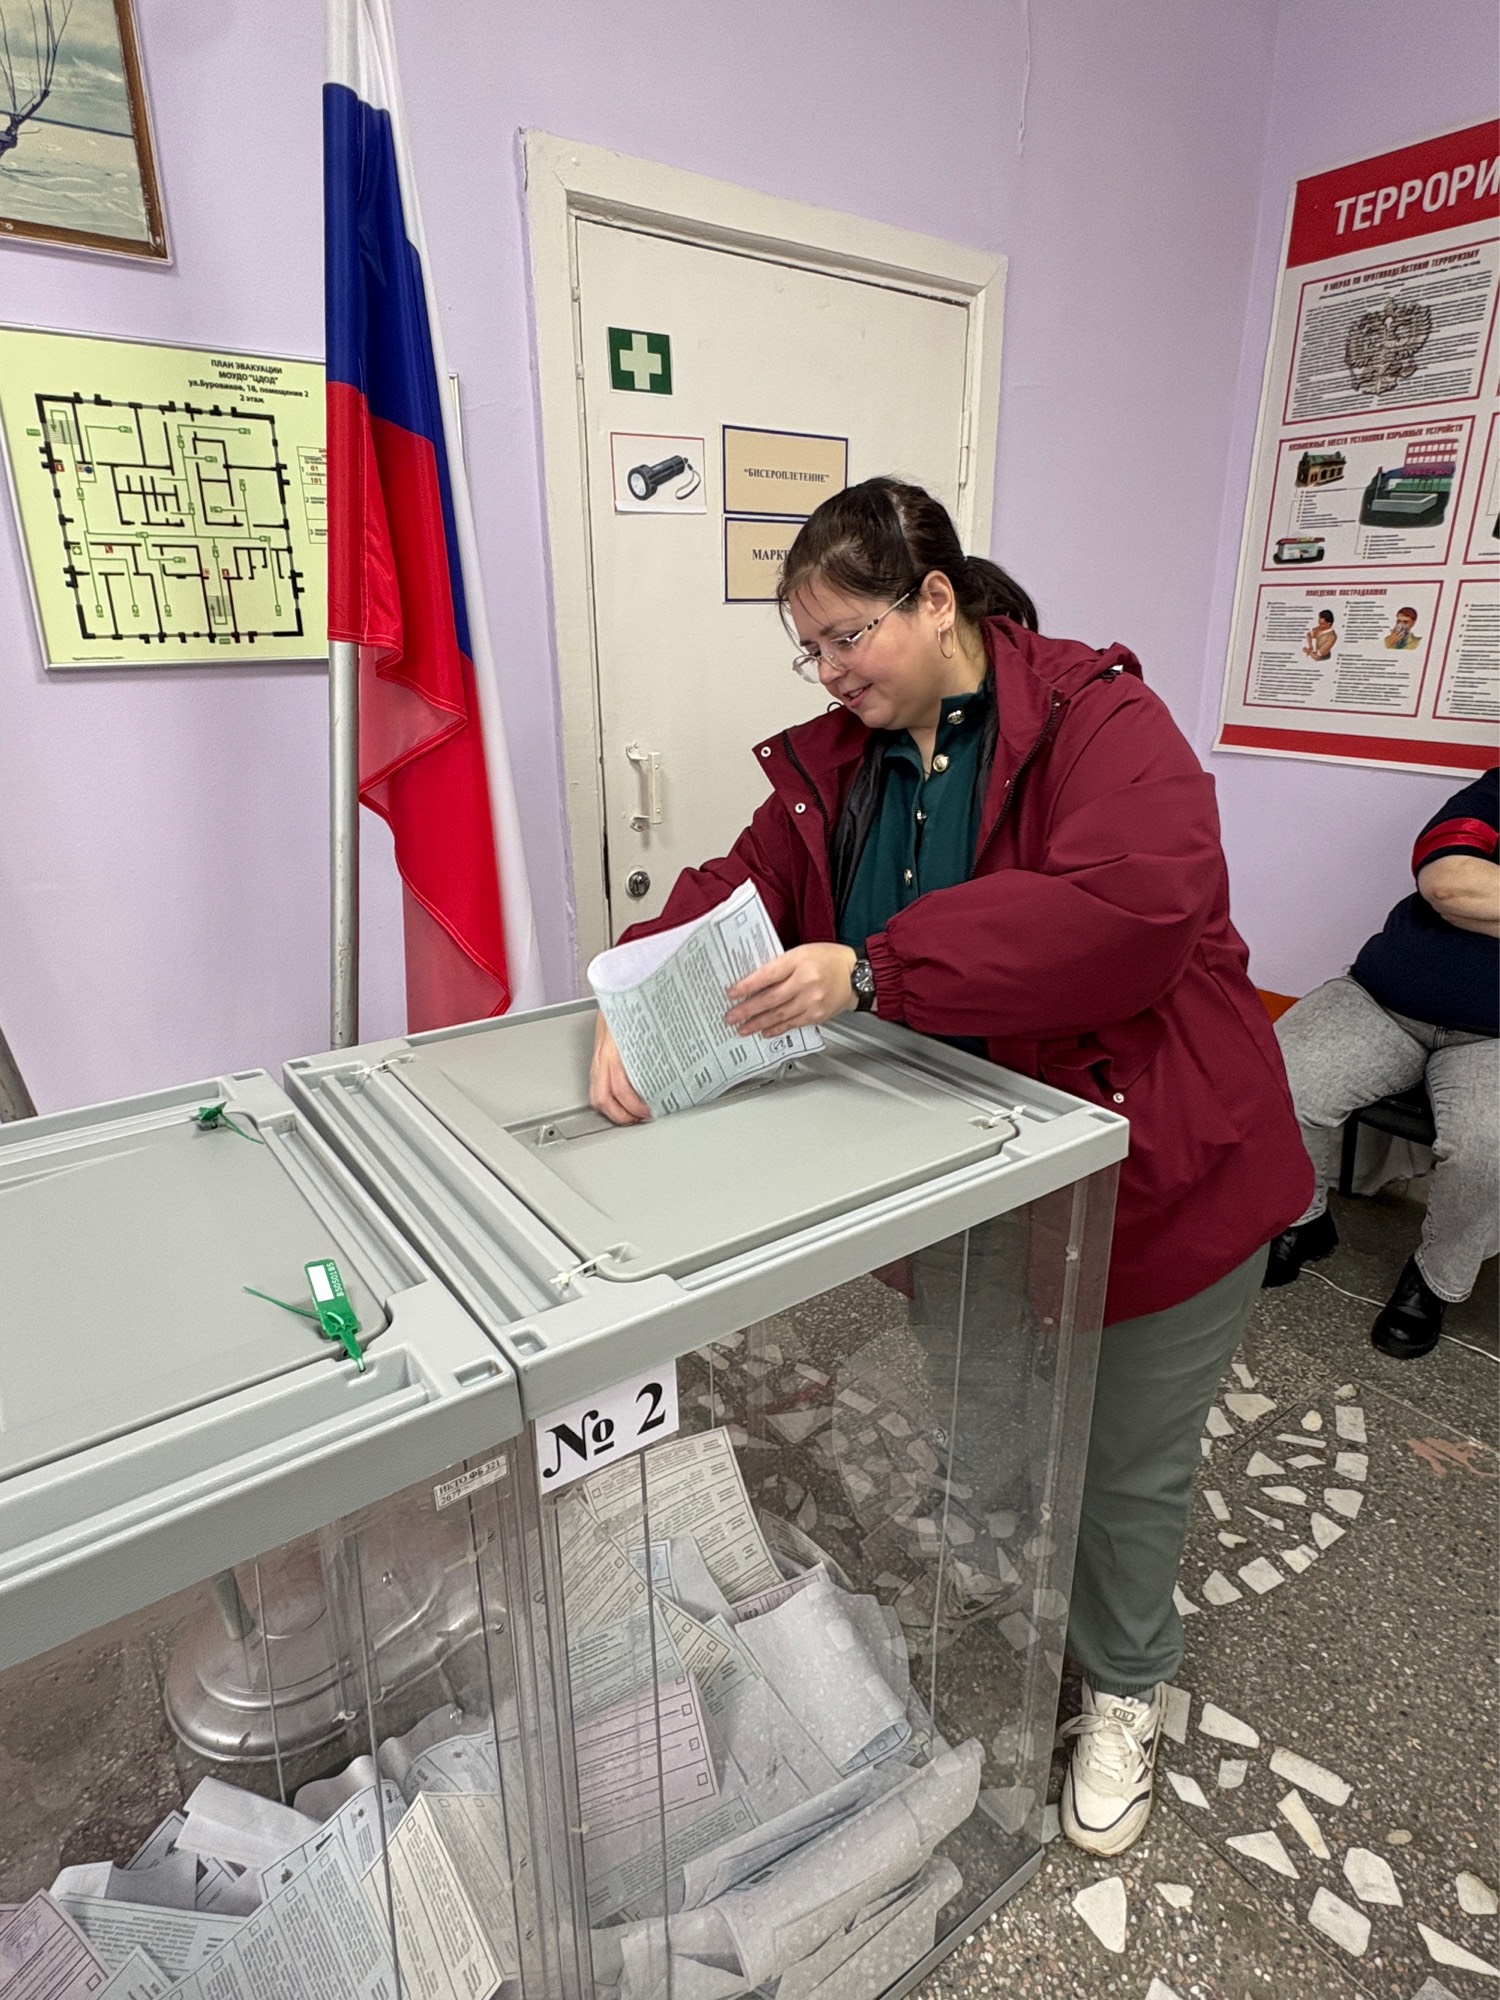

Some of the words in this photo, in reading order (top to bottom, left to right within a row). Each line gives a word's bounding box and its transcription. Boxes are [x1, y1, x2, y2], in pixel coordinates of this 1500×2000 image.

[1334, 155, 1500, 236] ТЕРРОРИ
[211, 359, 234, 369] ПЛАН
[236, 361, 283, 374] ЭВАКУАЦИИ
[240, 394, 245, 402] 2
[543, 1409, 615, 1479] №
[635, 1382, 666, 1436] 2
